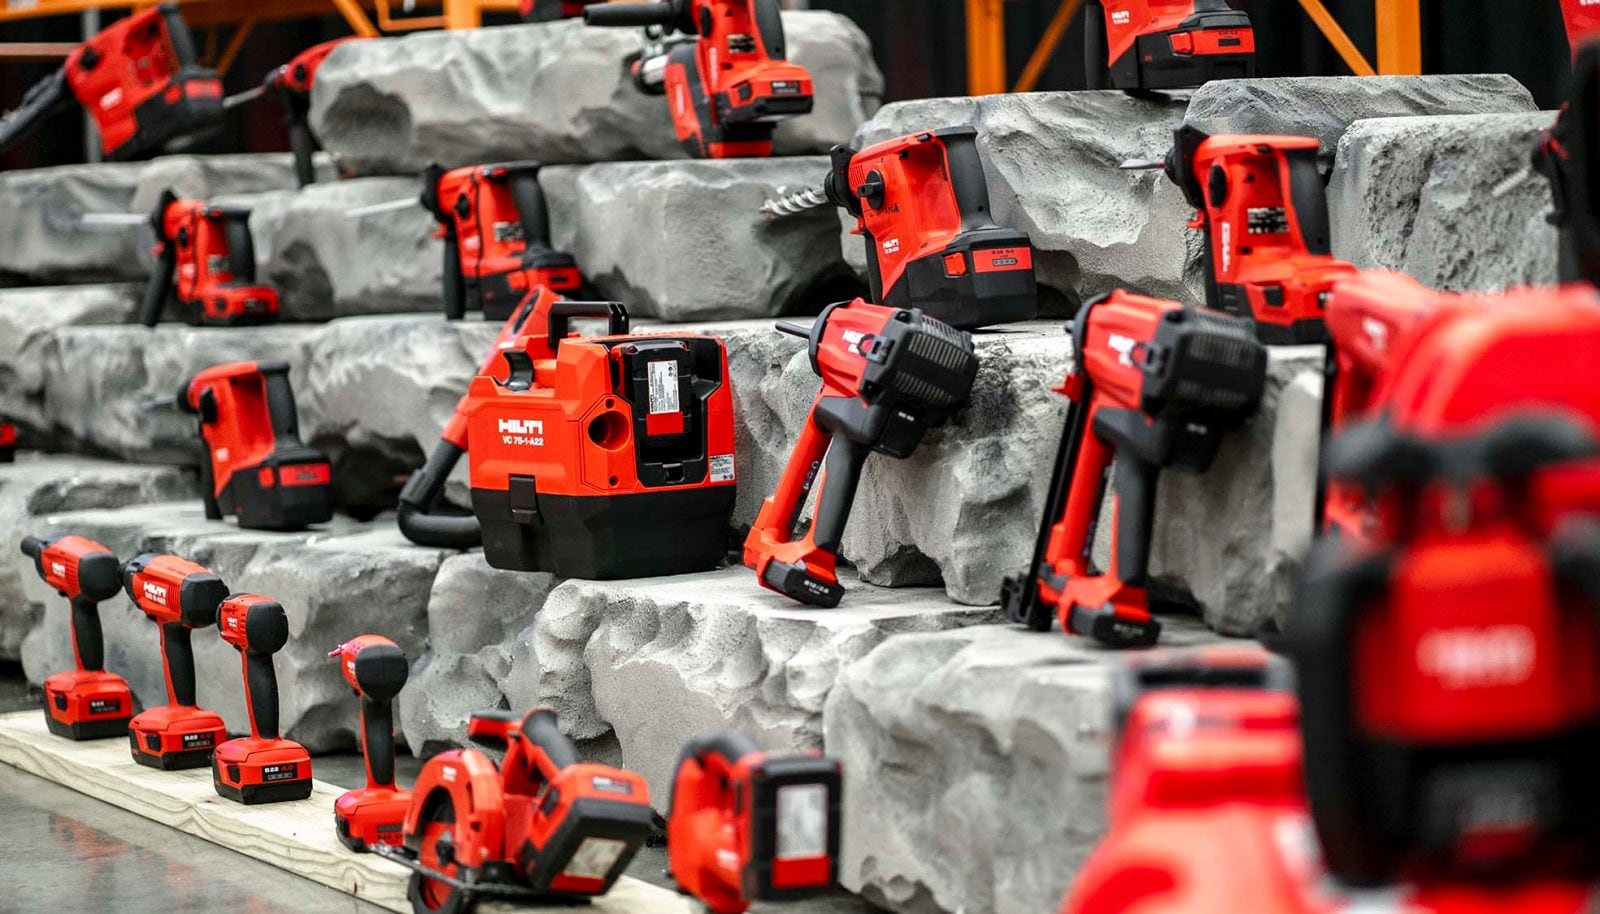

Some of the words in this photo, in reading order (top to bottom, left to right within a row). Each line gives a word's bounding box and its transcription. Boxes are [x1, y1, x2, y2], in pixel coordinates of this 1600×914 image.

[498, 418, 543, 434] HILTI
[503, 435, 513, 445] VC
[513, 436, 544, 447] 75-1-A22
[143, 581, 167, 599] HILTI
